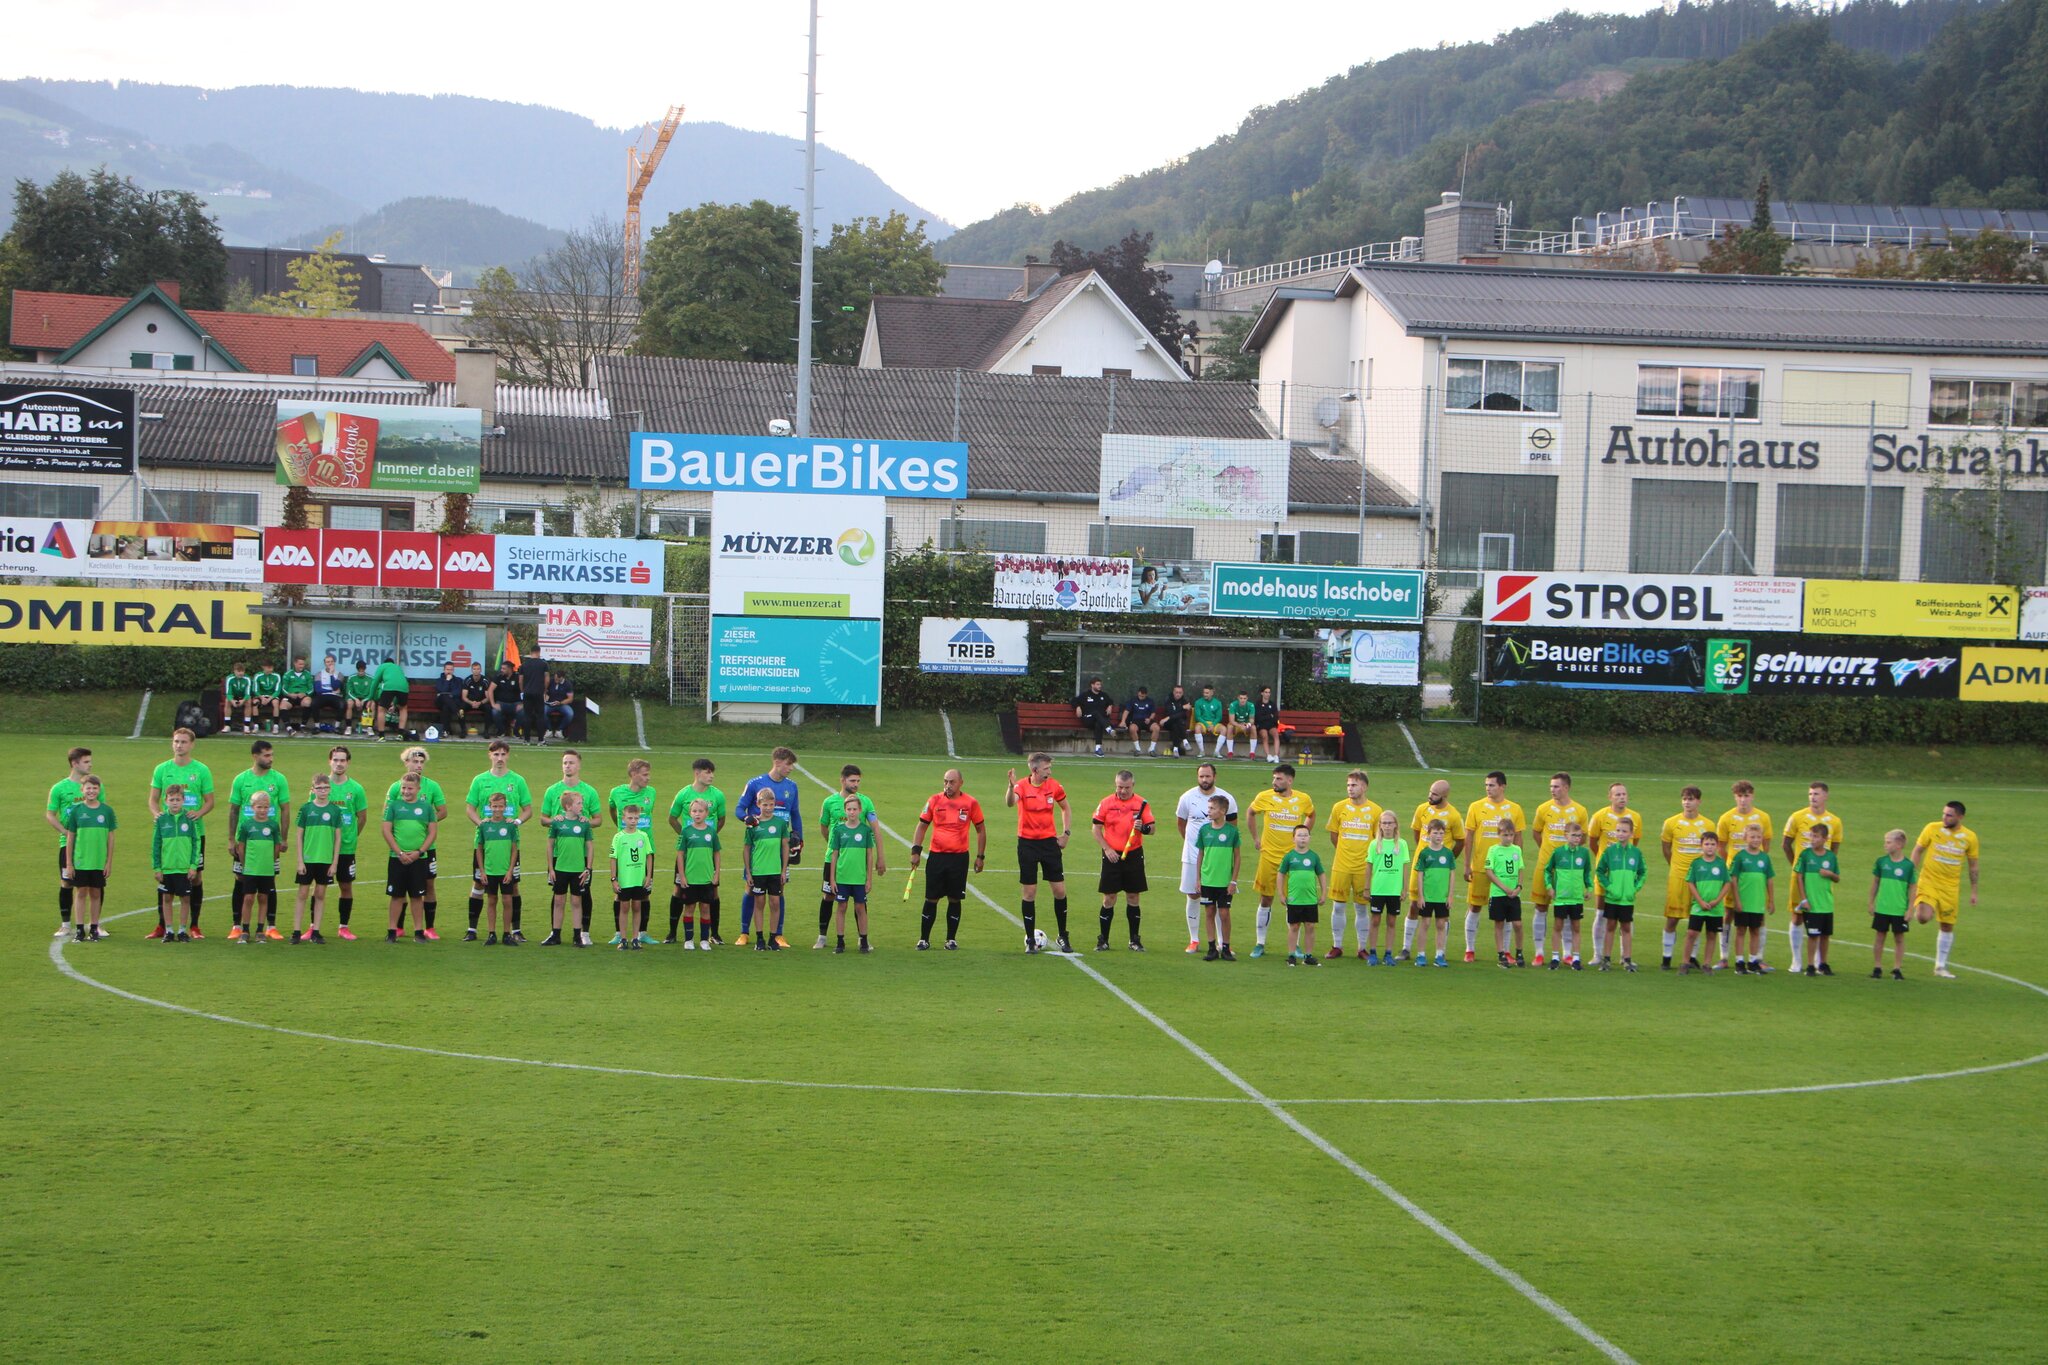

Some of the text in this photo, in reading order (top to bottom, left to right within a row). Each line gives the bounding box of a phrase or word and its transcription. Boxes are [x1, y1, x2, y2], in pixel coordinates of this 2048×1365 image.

[22, 403, 80, 412] Autozentrum
[5, 433, 108, 444] GLEISDORF VOITSBERG
[1601, 425, 1820, 470] Autohaus
[1530, 452, 1552, 460] OPEL
[377, 462, 474, 477] Immer dabei!
[641, 439, 958, 492] BauerBikes
[721, 531, 833, 555] MÜNZER
[211, 545, 257, 558] wärme design
[266, 545, 315, 566] ADA
[509, 547, 627, 564] Steiermärkische
[326, 547, 374, 569] ADA
[385, 549, 433, 570] ADA
[444, 551, 491, 573] ADA
[507, 564, 627, 583] SPARKASSE
[1222, 576, 1411, 602] modehaus laschober
[2027, 590, 2048, 598] SCH
[752, 599, 842, 609] www.muenzer.at
[994, 587, 1054, 608] Paracelsus
[1080, 590, 1128, 609] Apotheke
[1546, 583, 1723, 622] STROBL
[1915, 599, 1982, 609] Raiffeisenbank
[1283, 605, 1351, 617] menswear
[1812, 608, 1831, 616] WIR
[1929, 608, 1982, 618] Weiz-Anger
[546, 608, 615, 627] HARB
[1812, 617, 1857, 627] MÖGLICH
[724, 630, 756, 639] ZIESER
[948, 643, 995, 658] TRIEB
[1531, 639, 1670, 665] BauerBikes
[720, 655, 786, 666] TREFFSICHERE
[1754, 651, 1879, 675] schwarz
[720, 667, 800, 678] GESCHENKSIDEEN
[1556, 664, 1643, 674] E-BIKE STORE
[1753, 674, 1876, 686] BUSREISEN
[729, 683, 811, 694] juwelier-zieser.shop
[1269, 812, 1299, 820] Oberbank
[1342, 821, 1370, 829] Oberbank
